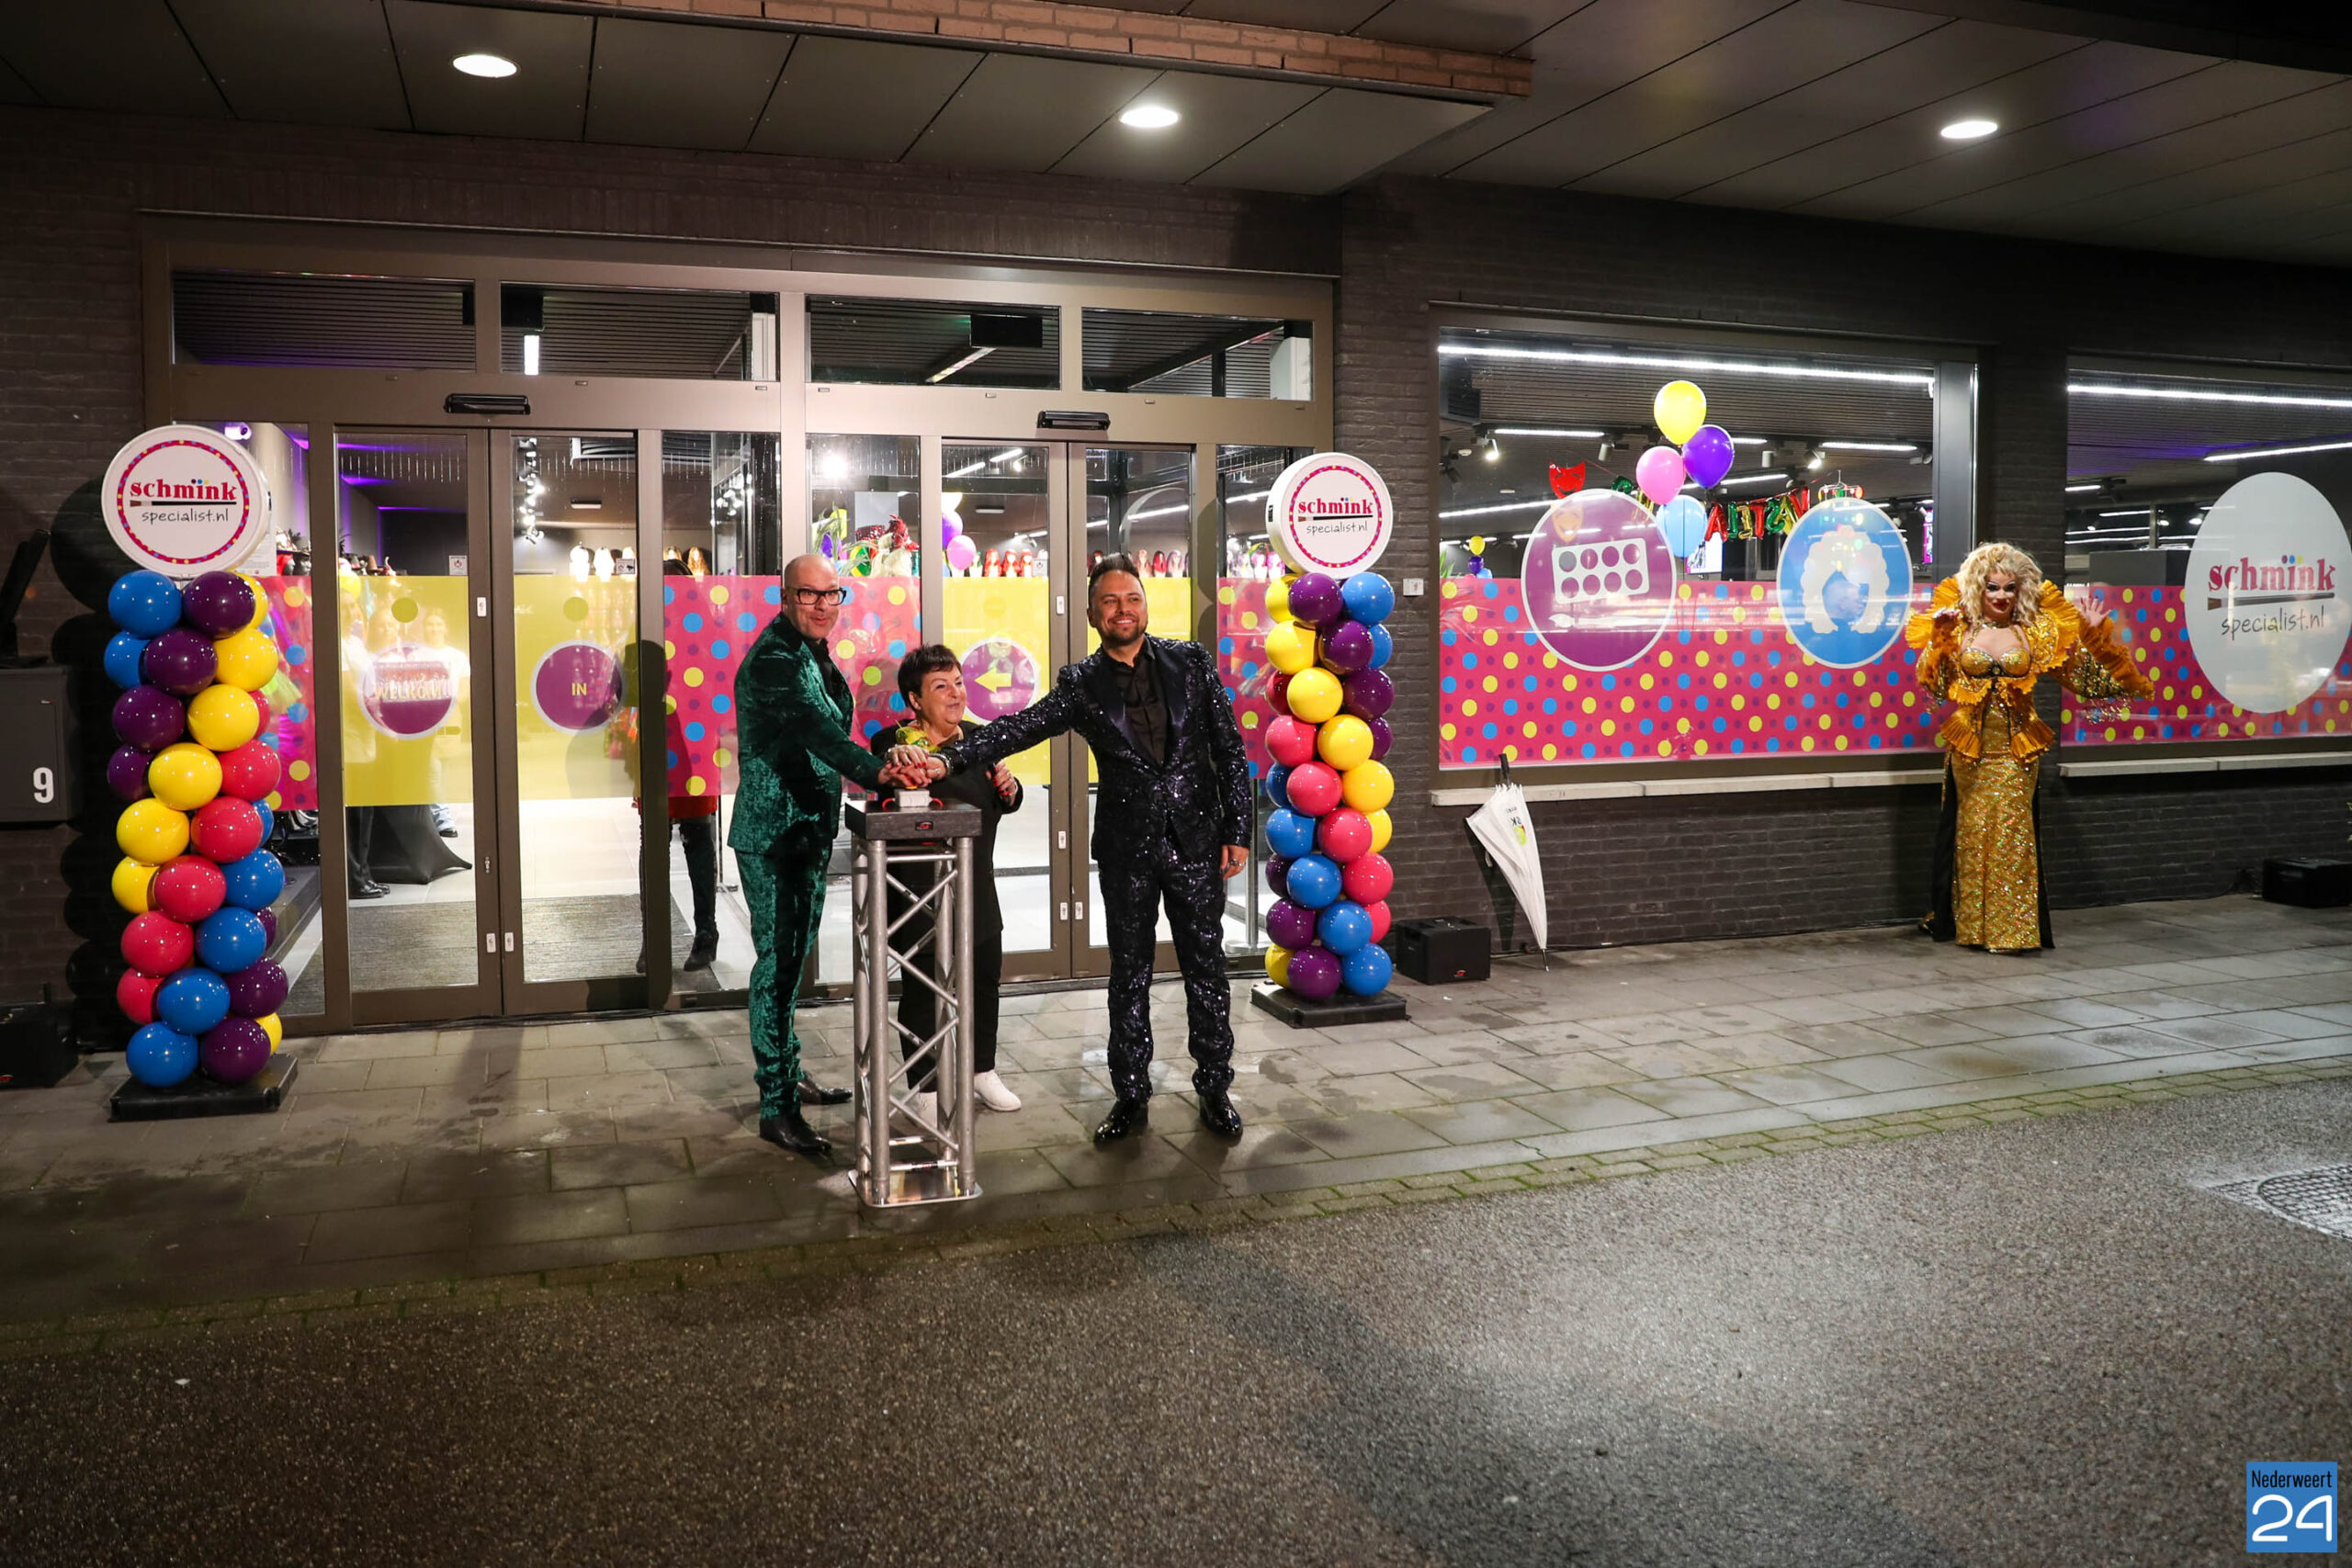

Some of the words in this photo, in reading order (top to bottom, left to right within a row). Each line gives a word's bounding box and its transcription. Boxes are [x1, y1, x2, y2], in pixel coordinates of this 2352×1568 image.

[130, 479, 237, 501] schmink
[1297, 497, 1374, 515] schmink
[141, 508, 229, 526] specialist.nl
[1306, 521, 1368, 536] specialist.nl
[2208, 555, 2336, 592] schmink
[2221, 604, 2325, 641] specialist.nl
[374, 683, 444, 701] WELKOM
[571, 682, 588, 696] IN
[32, 766, 55, 804] 9
